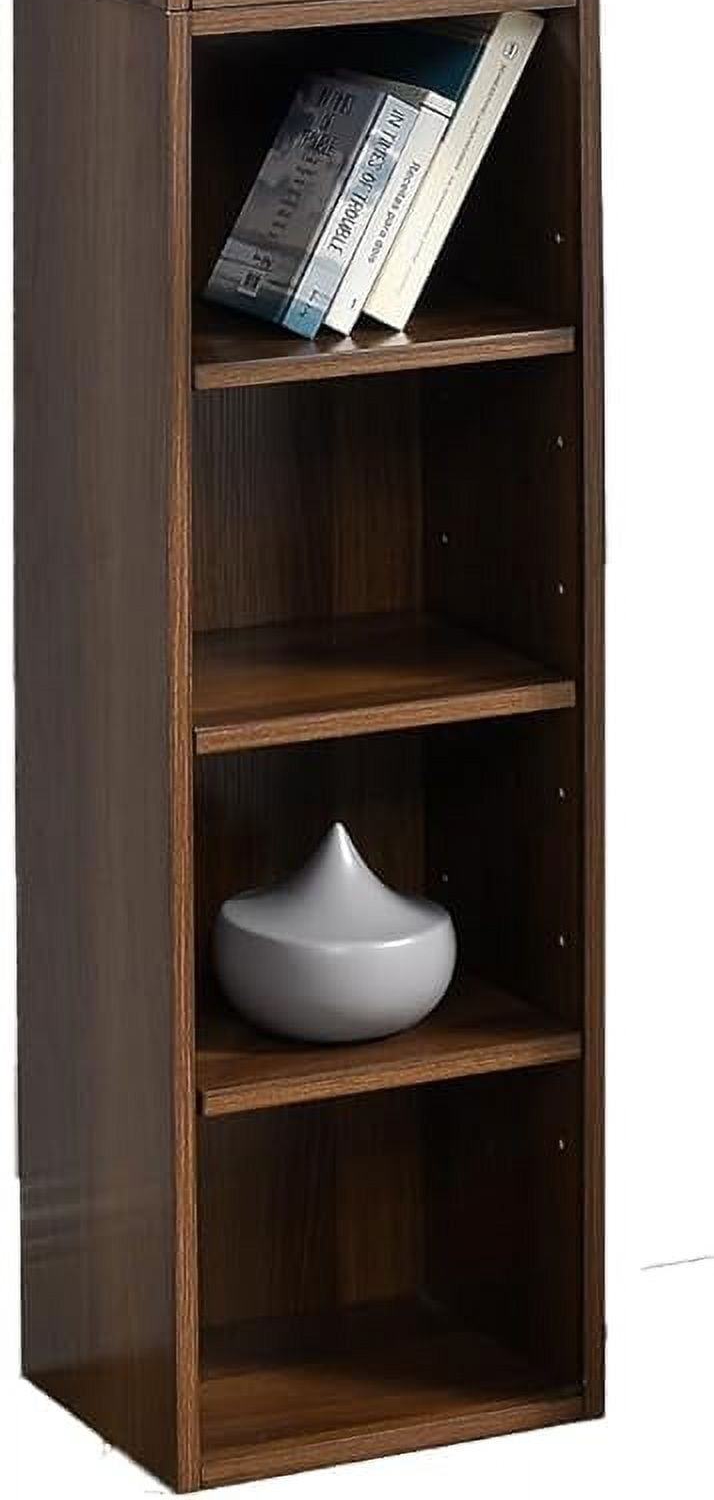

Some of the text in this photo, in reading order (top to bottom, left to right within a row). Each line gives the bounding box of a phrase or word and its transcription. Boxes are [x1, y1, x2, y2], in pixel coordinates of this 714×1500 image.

[327, 108, 406, 256] IN TIMES OF TROUBLE
[379, 211, 397, 239] para
